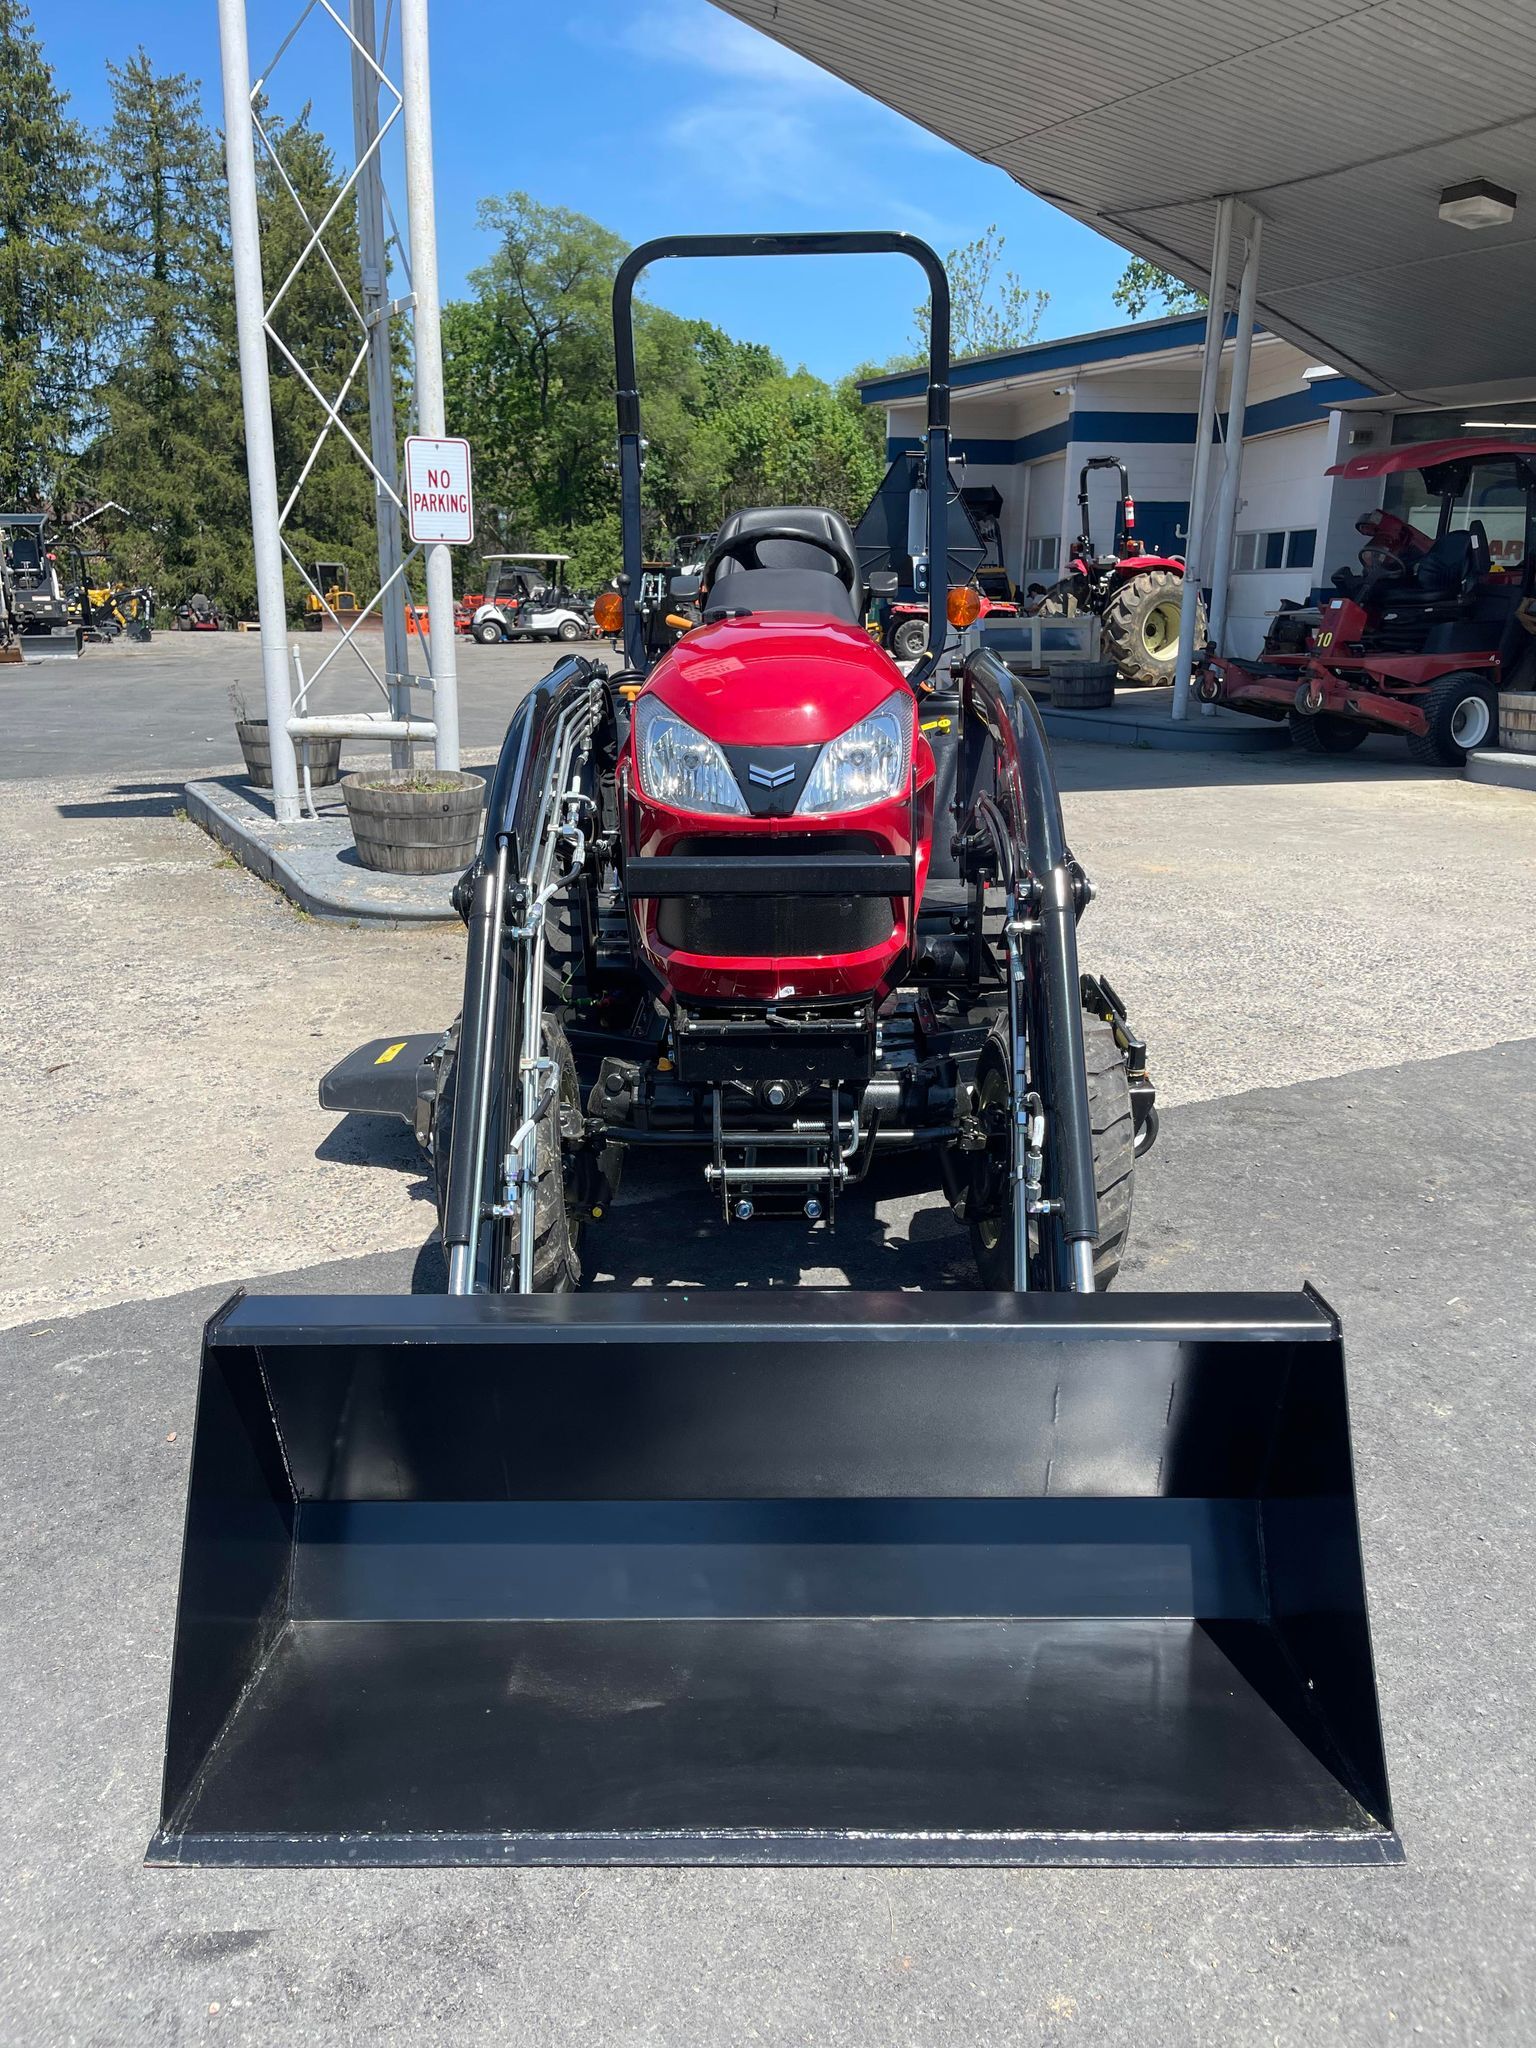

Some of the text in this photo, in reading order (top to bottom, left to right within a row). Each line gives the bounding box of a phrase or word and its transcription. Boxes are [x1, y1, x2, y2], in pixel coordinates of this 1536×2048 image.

[427, 469, 451, 489] NO
[413, 493, 467, 513] PARKING
[1317, 632, 1333, 648] 10
